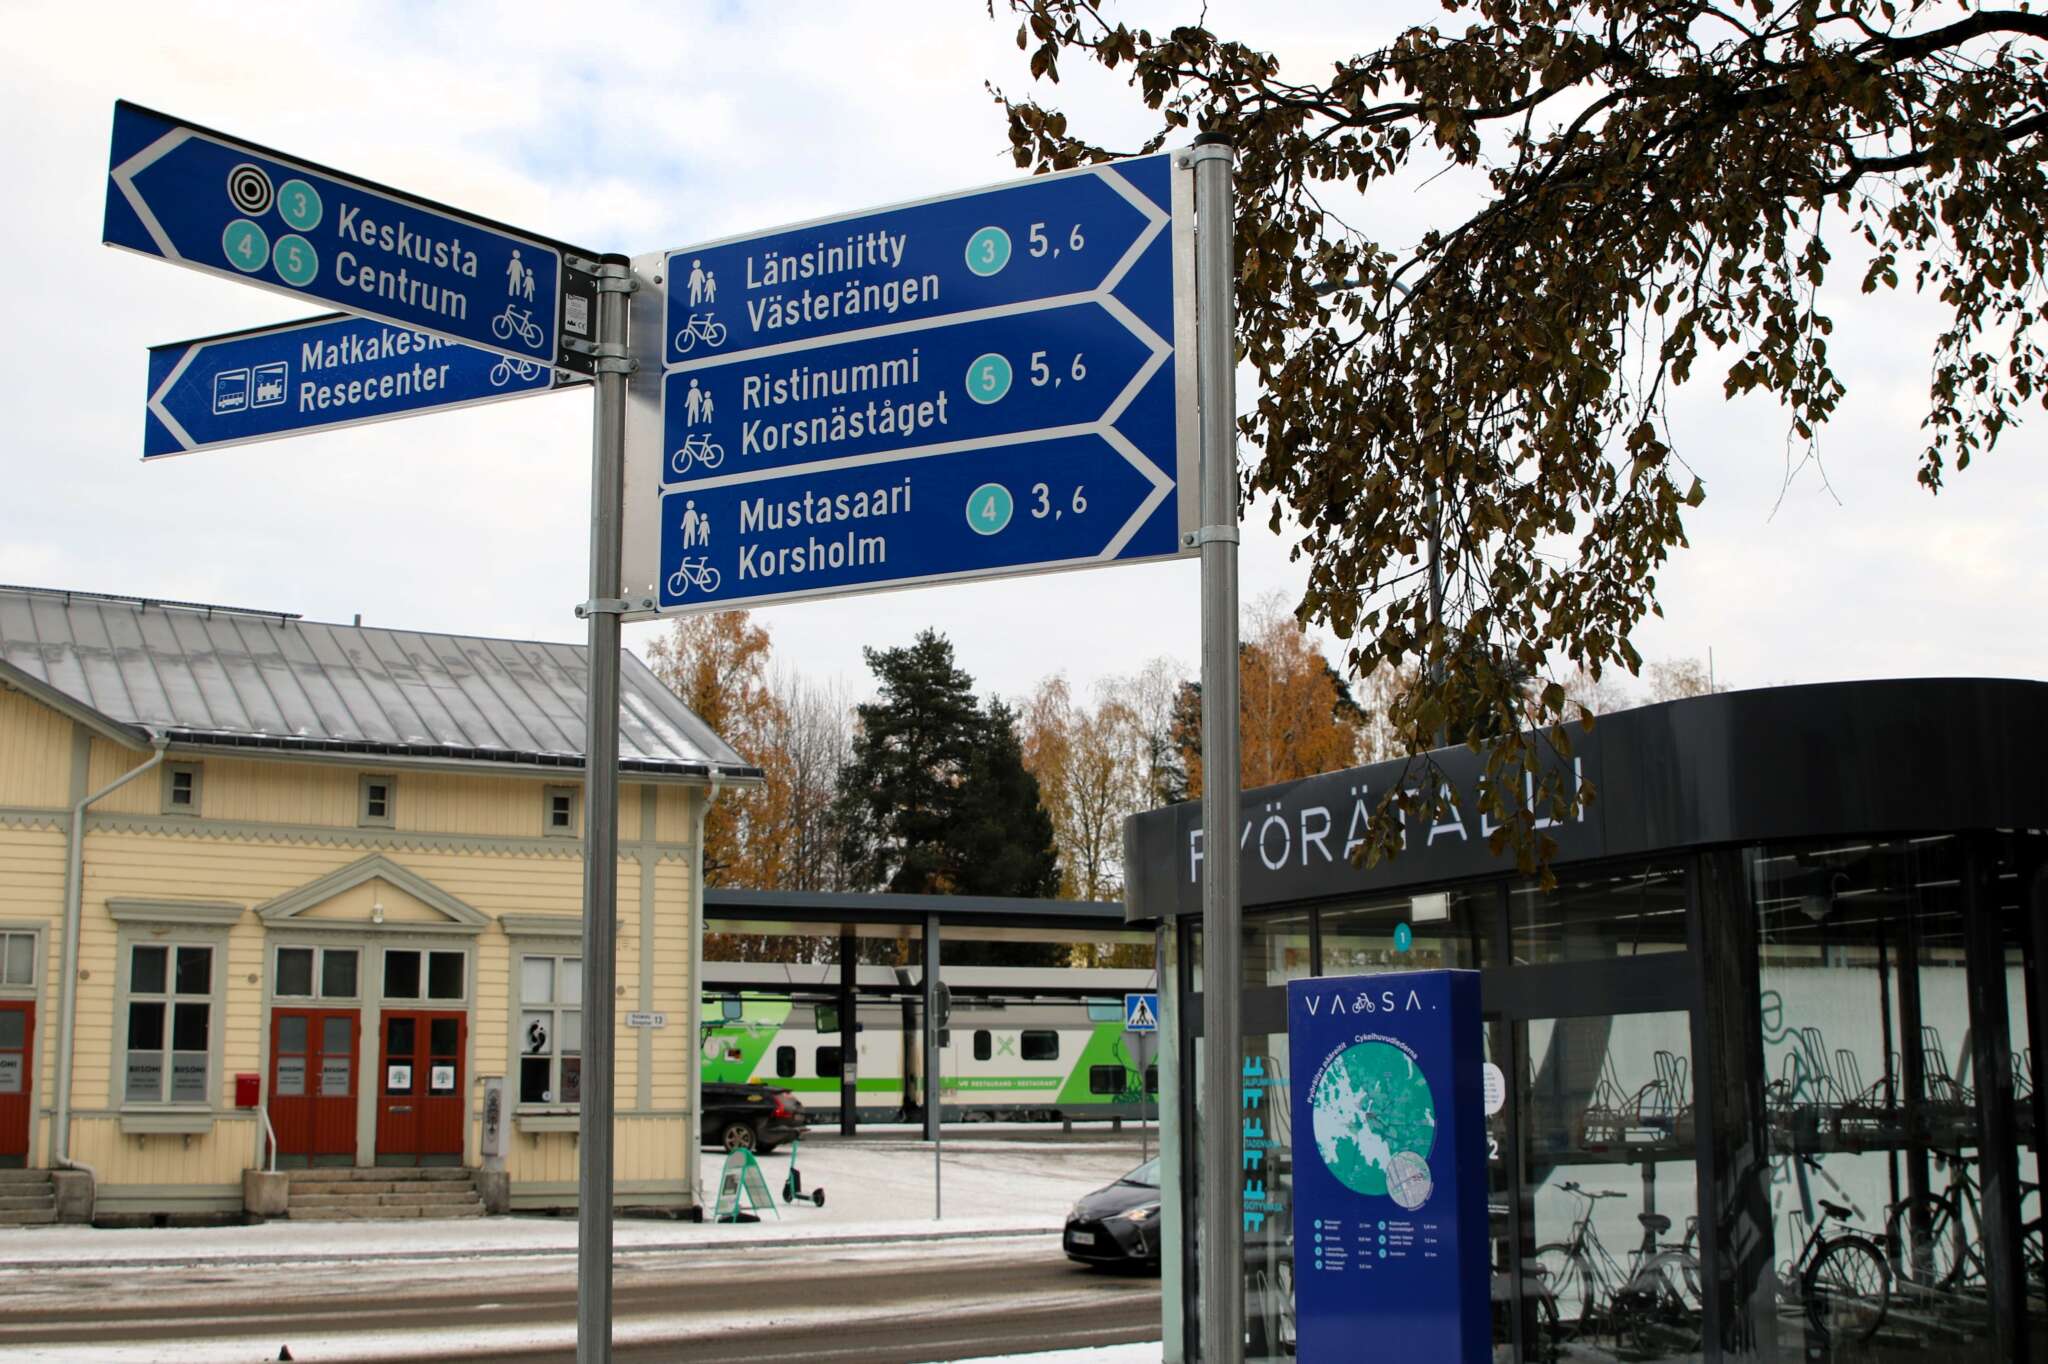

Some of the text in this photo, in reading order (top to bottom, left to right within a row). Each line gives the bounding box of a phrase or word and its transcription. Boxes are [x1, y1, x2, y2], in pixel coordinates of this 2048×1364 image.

[293, 192, 306, 219] 3
[238, 233, 302, 273] 4 5
[338, 202, 479, 279] Keskusta
[745, 232, 907, 290] Länsiniitty
[981, 239, 995, 264] 3
[335, 250, 468, 321] Centrum
[747, 272, 940, 333] Västerängen
[298, 362, 450, 413] Resecenter
[742, 348, 920, 411] Ristinummi
[981, 366, 996, 391] 5
[741, 390, 948, 456] Korsnäståget
[739, 477, 912, 535] Mustasaari
[981, 496, 997, 522] 4
[738, 531, 886, 580] Korsholm
